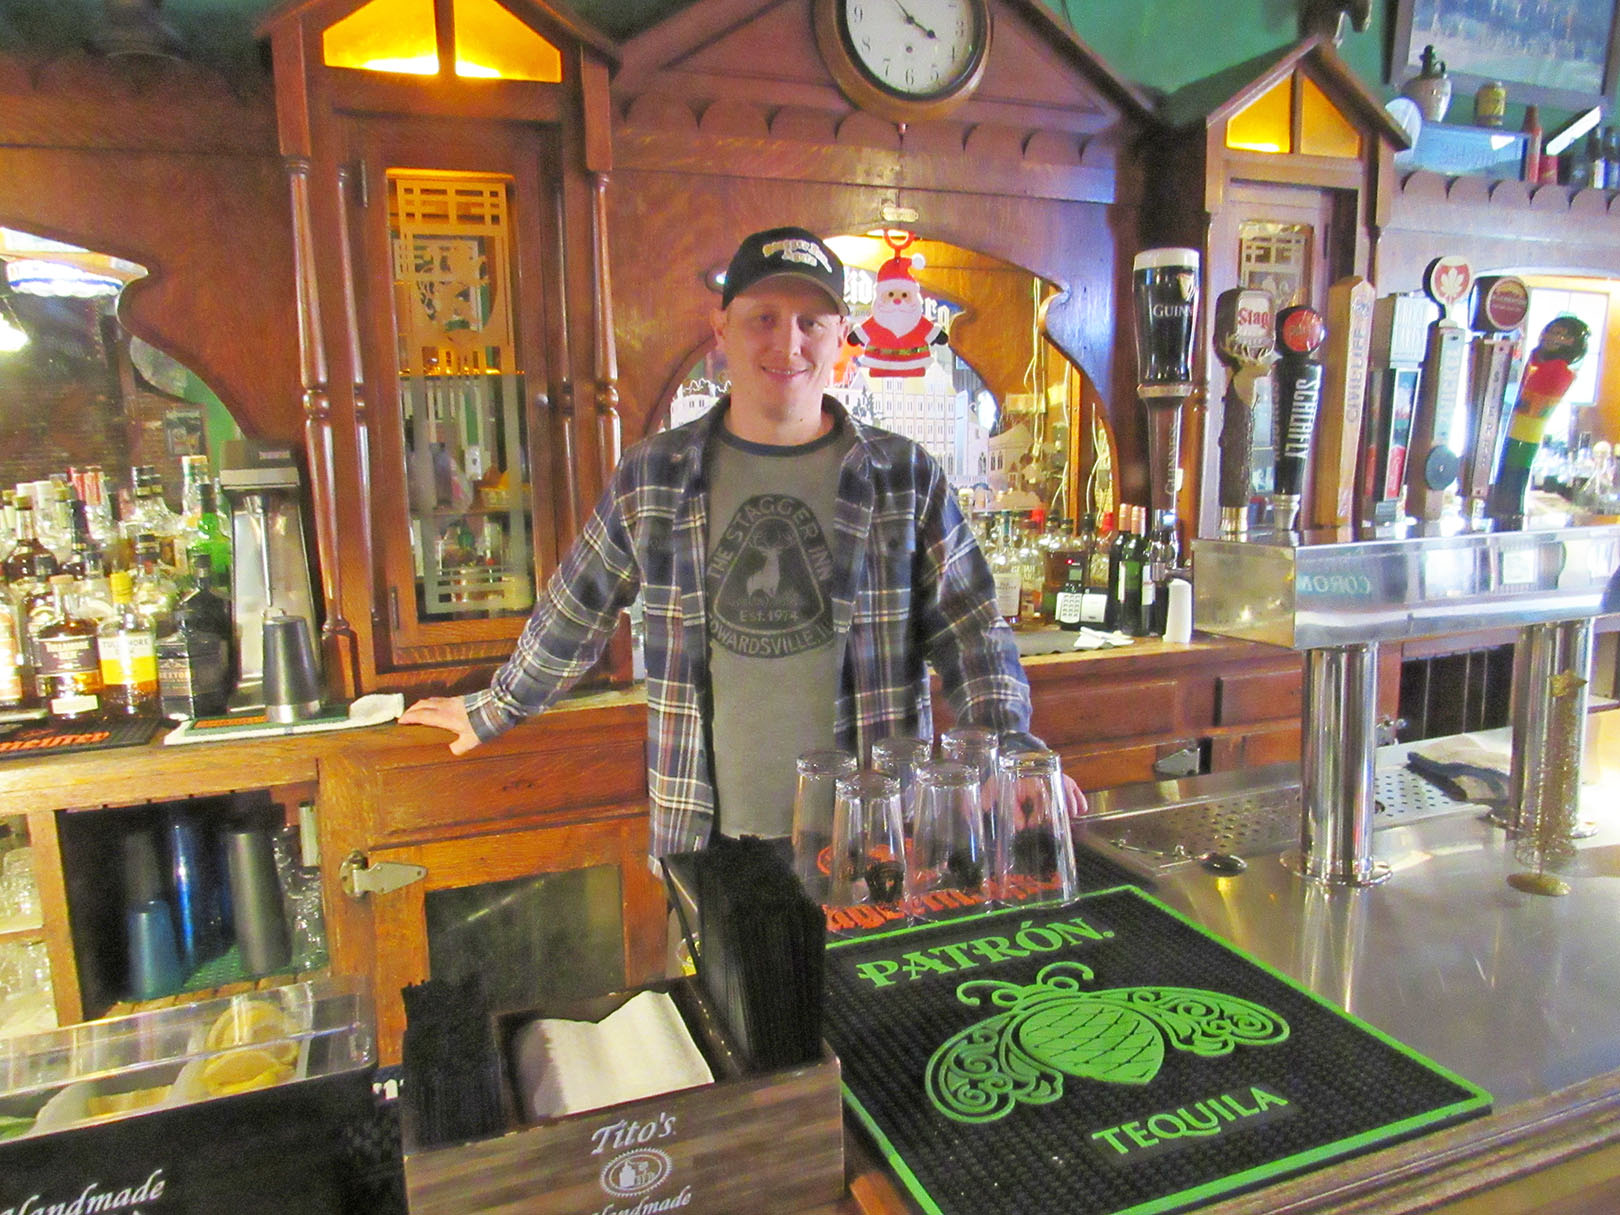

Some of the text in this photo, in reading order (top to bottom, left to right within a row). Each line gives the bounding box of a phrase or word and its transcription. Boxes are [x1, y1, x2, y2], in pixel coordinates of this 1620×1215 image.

[883, 58, 891, 77] 7
[905, 68, 914, 86] 6
[1284, 378, 1321, 459] SCHLAFLY
[709, 496, 833, 582] THE STAGGER INN
[768, 608, 799, 622] 1974
[591, 1111, 677, 1155] Tito's
[1091, 1086, 1289, 1156] TEQUILA
